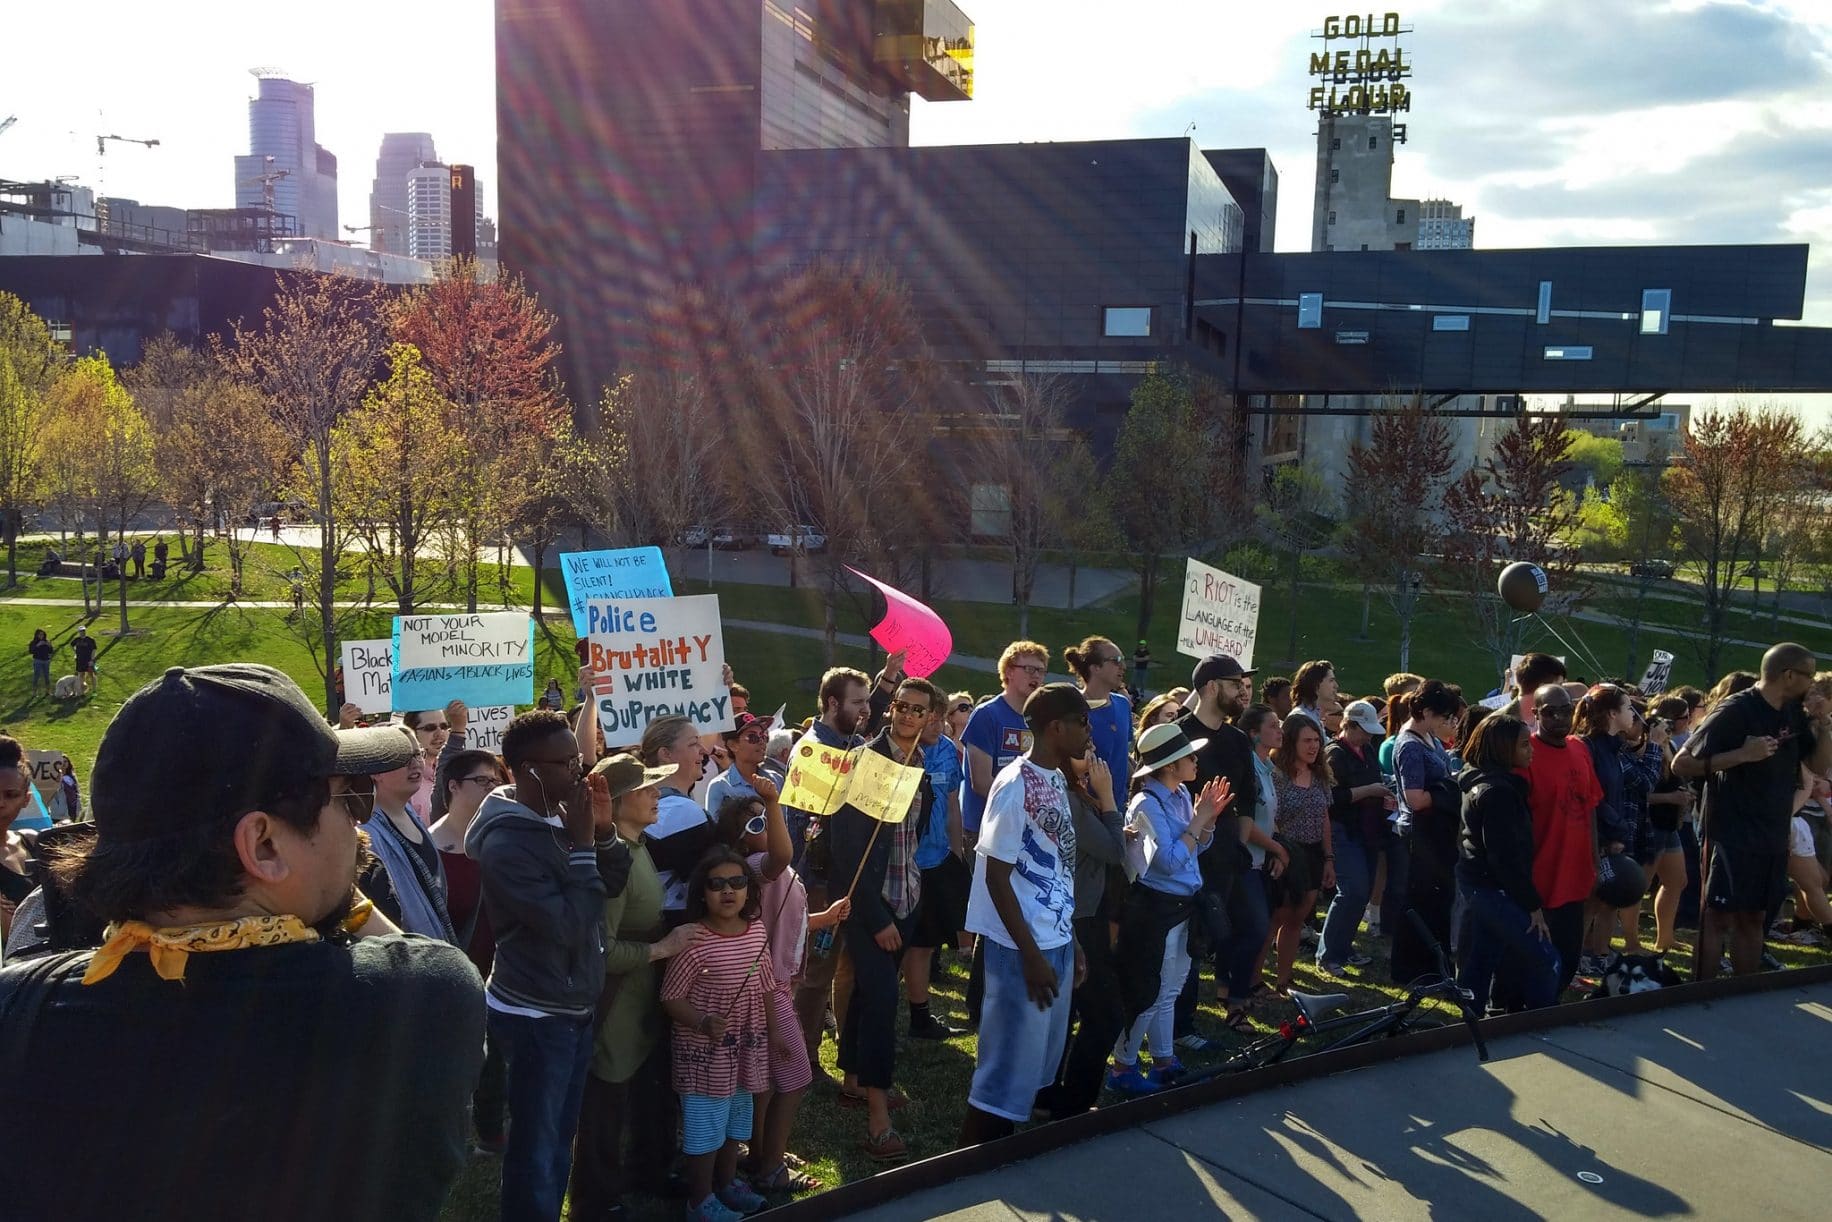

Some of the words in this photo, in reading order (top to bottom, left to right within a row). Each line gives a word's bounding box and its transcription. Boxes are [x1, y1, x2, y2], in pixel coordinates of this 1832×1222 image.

[1324, 12, 1399, 39] GOLD
[1310, 48, 1410, 75] MEDAL
[1310, 83, 1405, 110] FLOUR
[568, 557, 590, 574] WE
[592, 557, 612, 569] WILL
[615, 556, 632, 568] NOT
[634, 555, 647, 567] BE
[574, 574, 613, 591] SILENT!
[1205, 573, 1236, 603] RIOT
[1243, 594, 1257, 613] the
[403, 617, 432, 632] NOT
[440, 615, 484, 630] YOUR
[588, 604, 657, 634] Police
[1185, 598, 1234, 633] LANGUAGE
[421, 630, 475, 645] MODEL
[442, 640, 527, 657] MINORITY
[351, 647, 392, 670] Black
[467, 706, 508, 723] Lives
